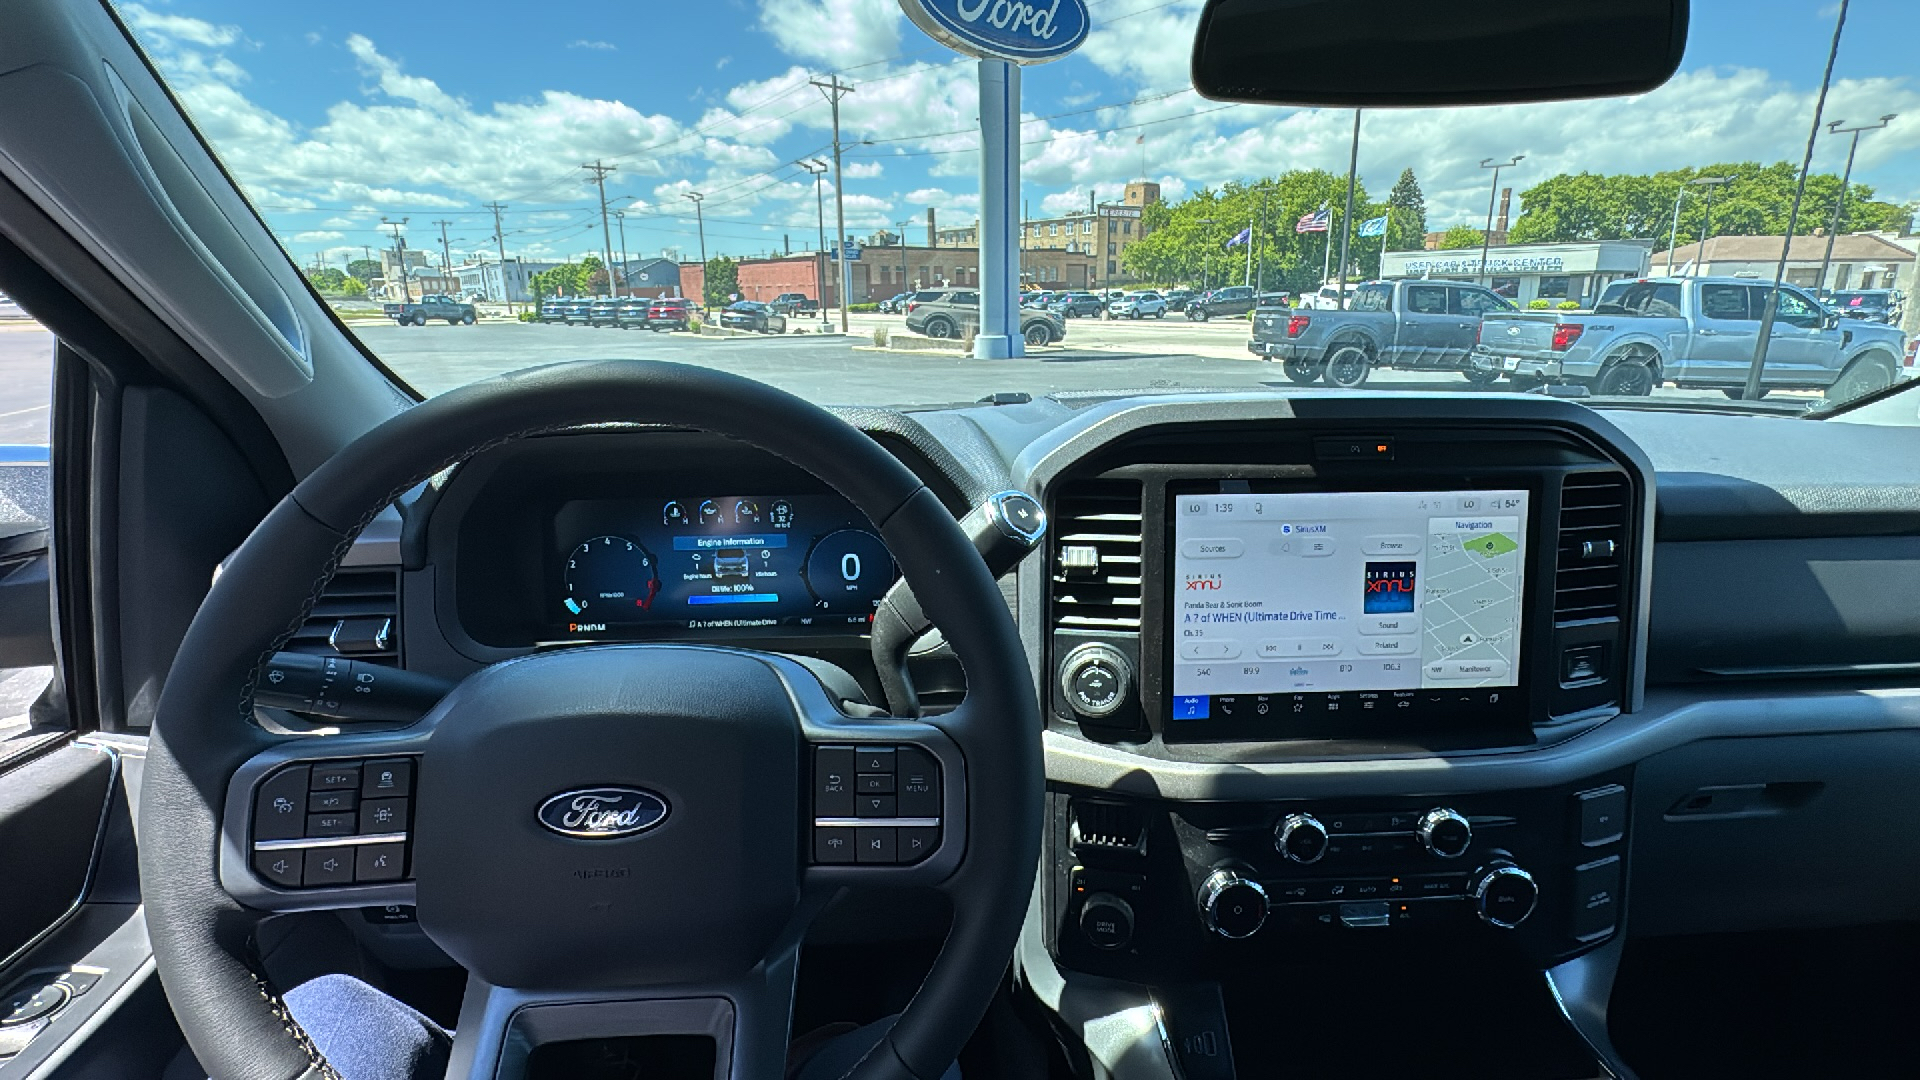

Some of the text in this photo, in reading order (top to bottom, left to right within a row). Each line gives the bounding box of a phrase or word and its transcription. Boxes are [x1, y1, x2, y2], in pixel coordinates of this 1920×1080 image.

[1405, 261, 1432, 269] USED
[1513, 257, 1563, 266] CENTER
[1215, 503, 1233, 513] 1:39
[1505, 499, 1520, 508] 54°
[1295, 525, 1327, 533] SiriusXM
[1455, 521, 1493, 530] Navigation
[604, 537, 611, 545] 4
[698, 538, 764, 547] Engine Information
[583, 543, 589, 552] 3
[626, 542, 633, 551] 5
[1200, 544, 1226, 553] Sources
[570, 560, 576, 568] 2
[642, 558, 648, 567] 6
[842, 554, 860, 580] 0
[1367, 571, 1414, 579] SIRIUS
[569, 583, 573, 591] 1
[734, 584, 754, 592] 100%
[581, 600, 588, 608] 0
[1184, 613, 1191, 623] A
[1194, 613, 1199, 622] ?
[1201, 612, 1210, 622] of
[1212, 612, 1242, 622] WHEN
[1244, 611, 1288, 624] (Ultimate
[1290, 611, 1312, 620] Drive
[1243, 667, 1260, 675] 89.9
[1078, 691, 1116, 706] PRO TRAILER
[563, 795, 642, 828] Ford
